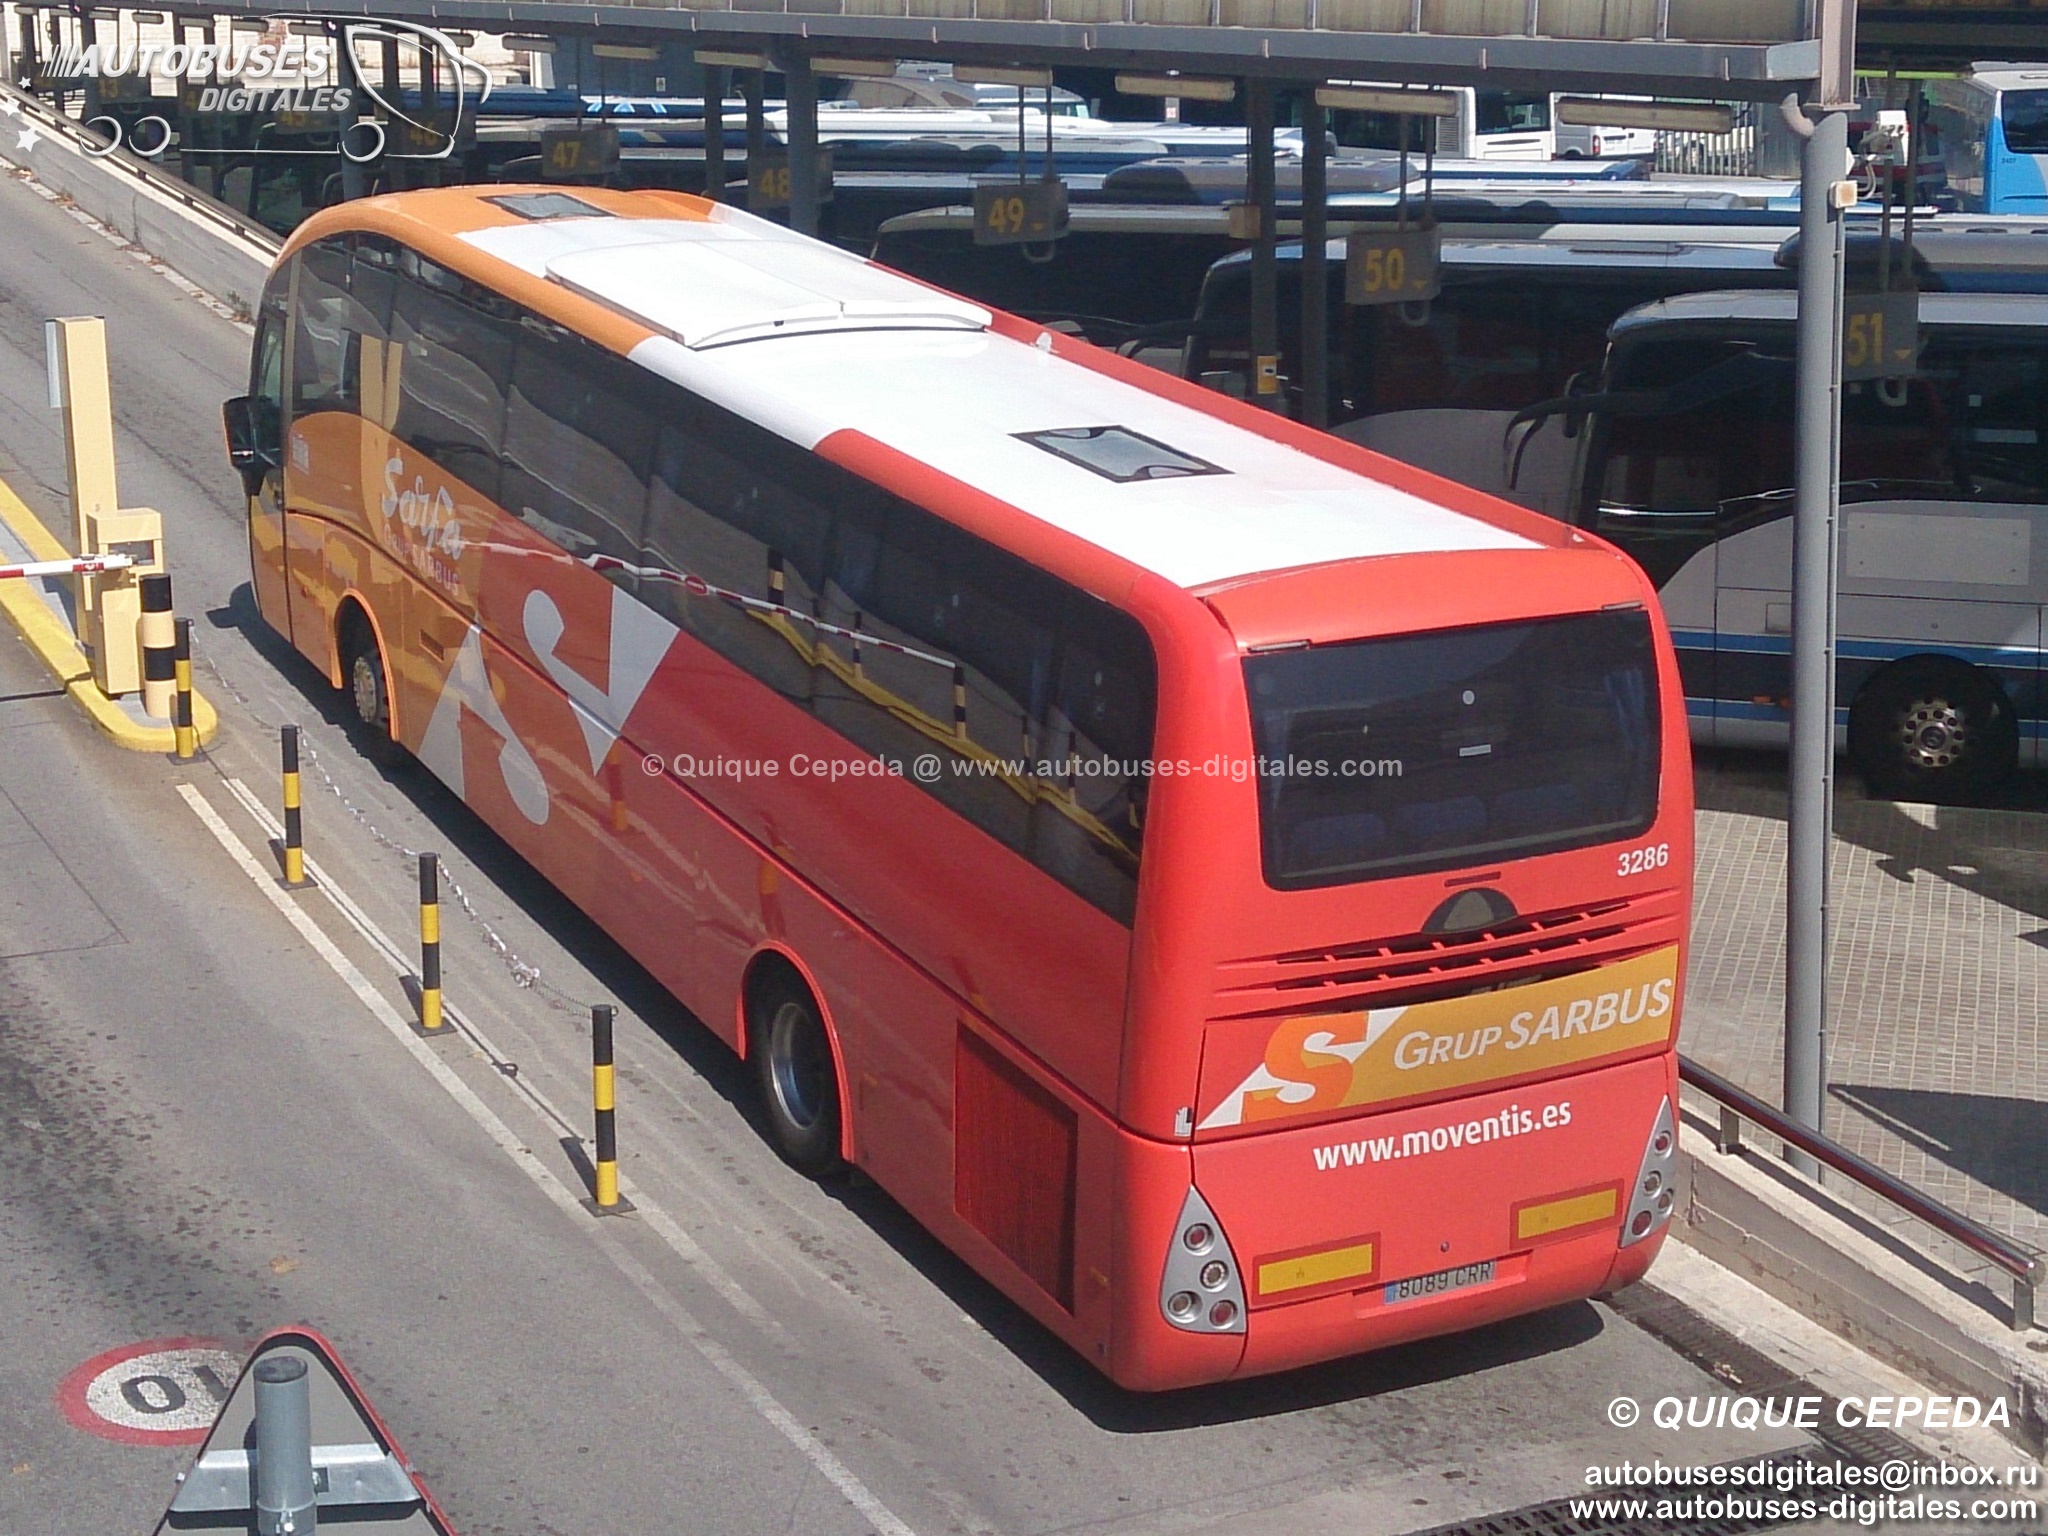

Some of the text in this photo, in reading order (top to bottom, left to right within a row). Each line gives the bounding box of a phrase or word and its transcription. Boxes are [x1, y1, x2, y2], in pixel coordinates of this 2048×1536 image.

[552, 140, 581, 169] 47
[759, 168, 790, 199] 48
[988, 197, 1024, 233] 49
[1364, 248, 1404, 292] 50
[1847, 312, 1883, 368] 51
[1616, 842, 1669, 877] 3286
[1394, 978, 1672, 1070] GRUP SARBUS
[1313, 1101, 1572, 1171] www.moventis.es
[1399, 1274, 1449, 1298] 8089
[1455, 1262, 1491, 1287] CRR
